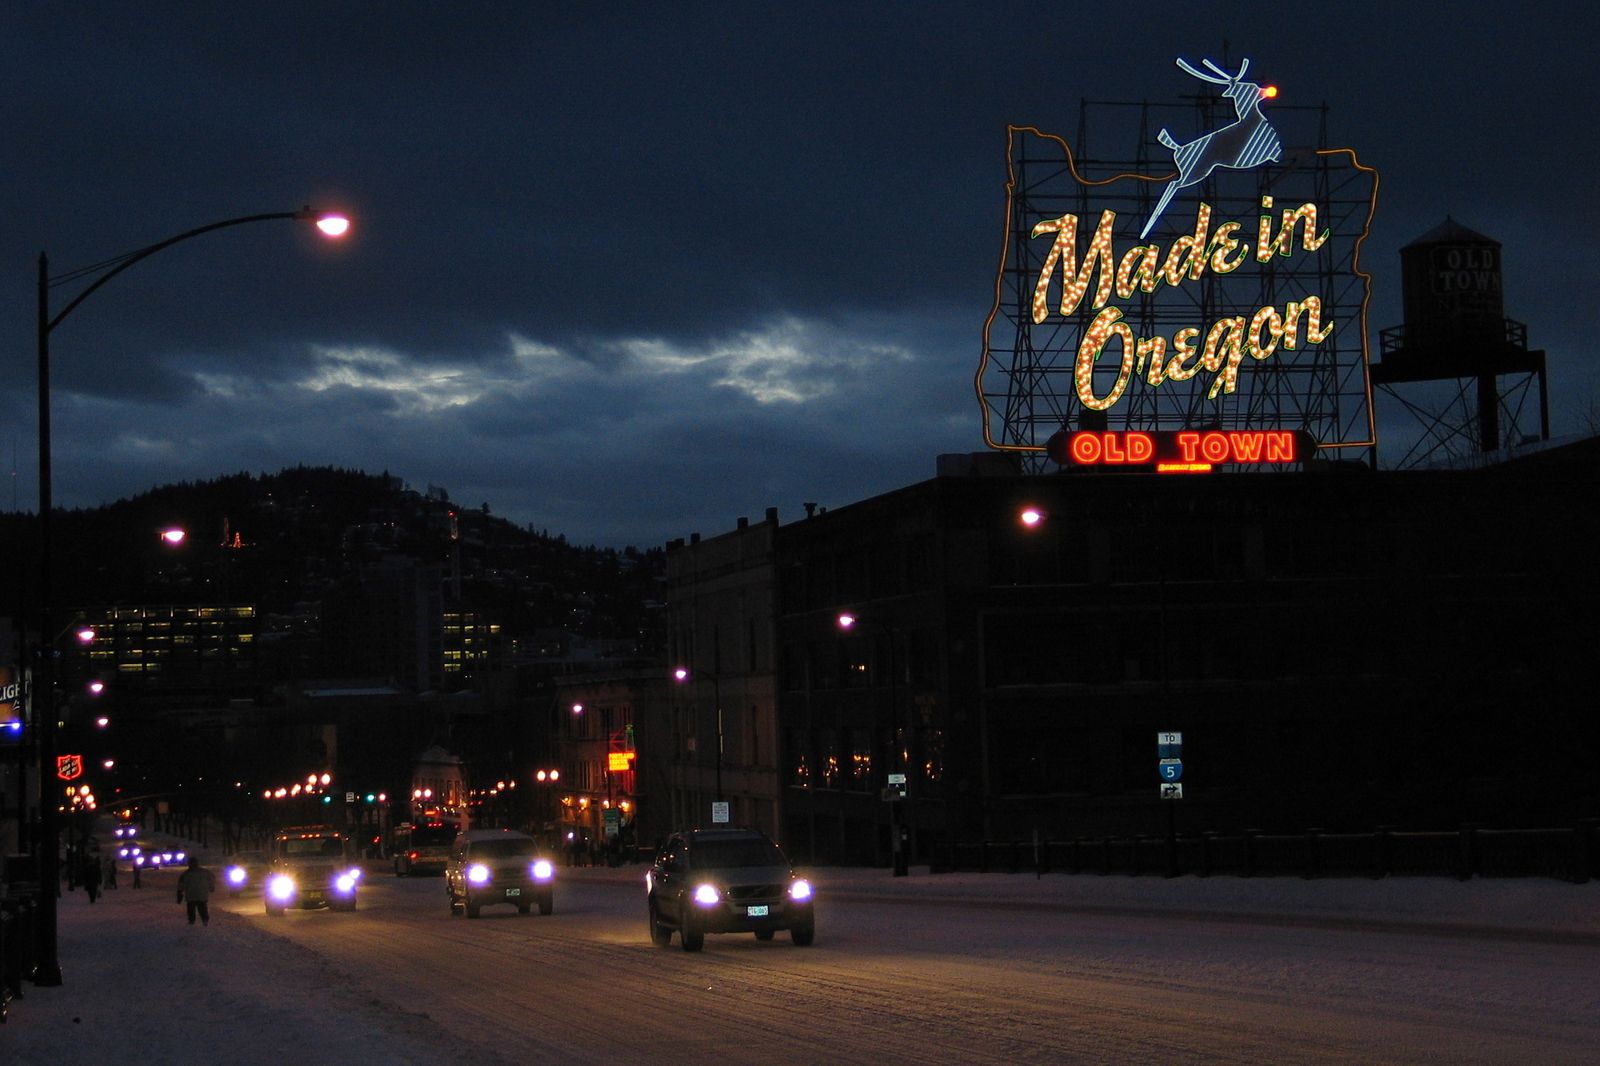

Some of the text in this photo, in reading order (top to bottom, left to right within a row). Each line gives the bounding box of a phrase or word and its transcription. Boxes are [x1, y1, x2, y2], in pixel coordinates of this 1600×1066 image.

[1031, 195, 1330, 325] Made in
[1447, 248, 1494, 270] OLD
[1075, 296, 1334, 411] Oregon
[1073, 433, 1294, 463] OLD TOWN
[1164, 734, 1176, 743] TO
[1166, 766, 1175, 778] 5
